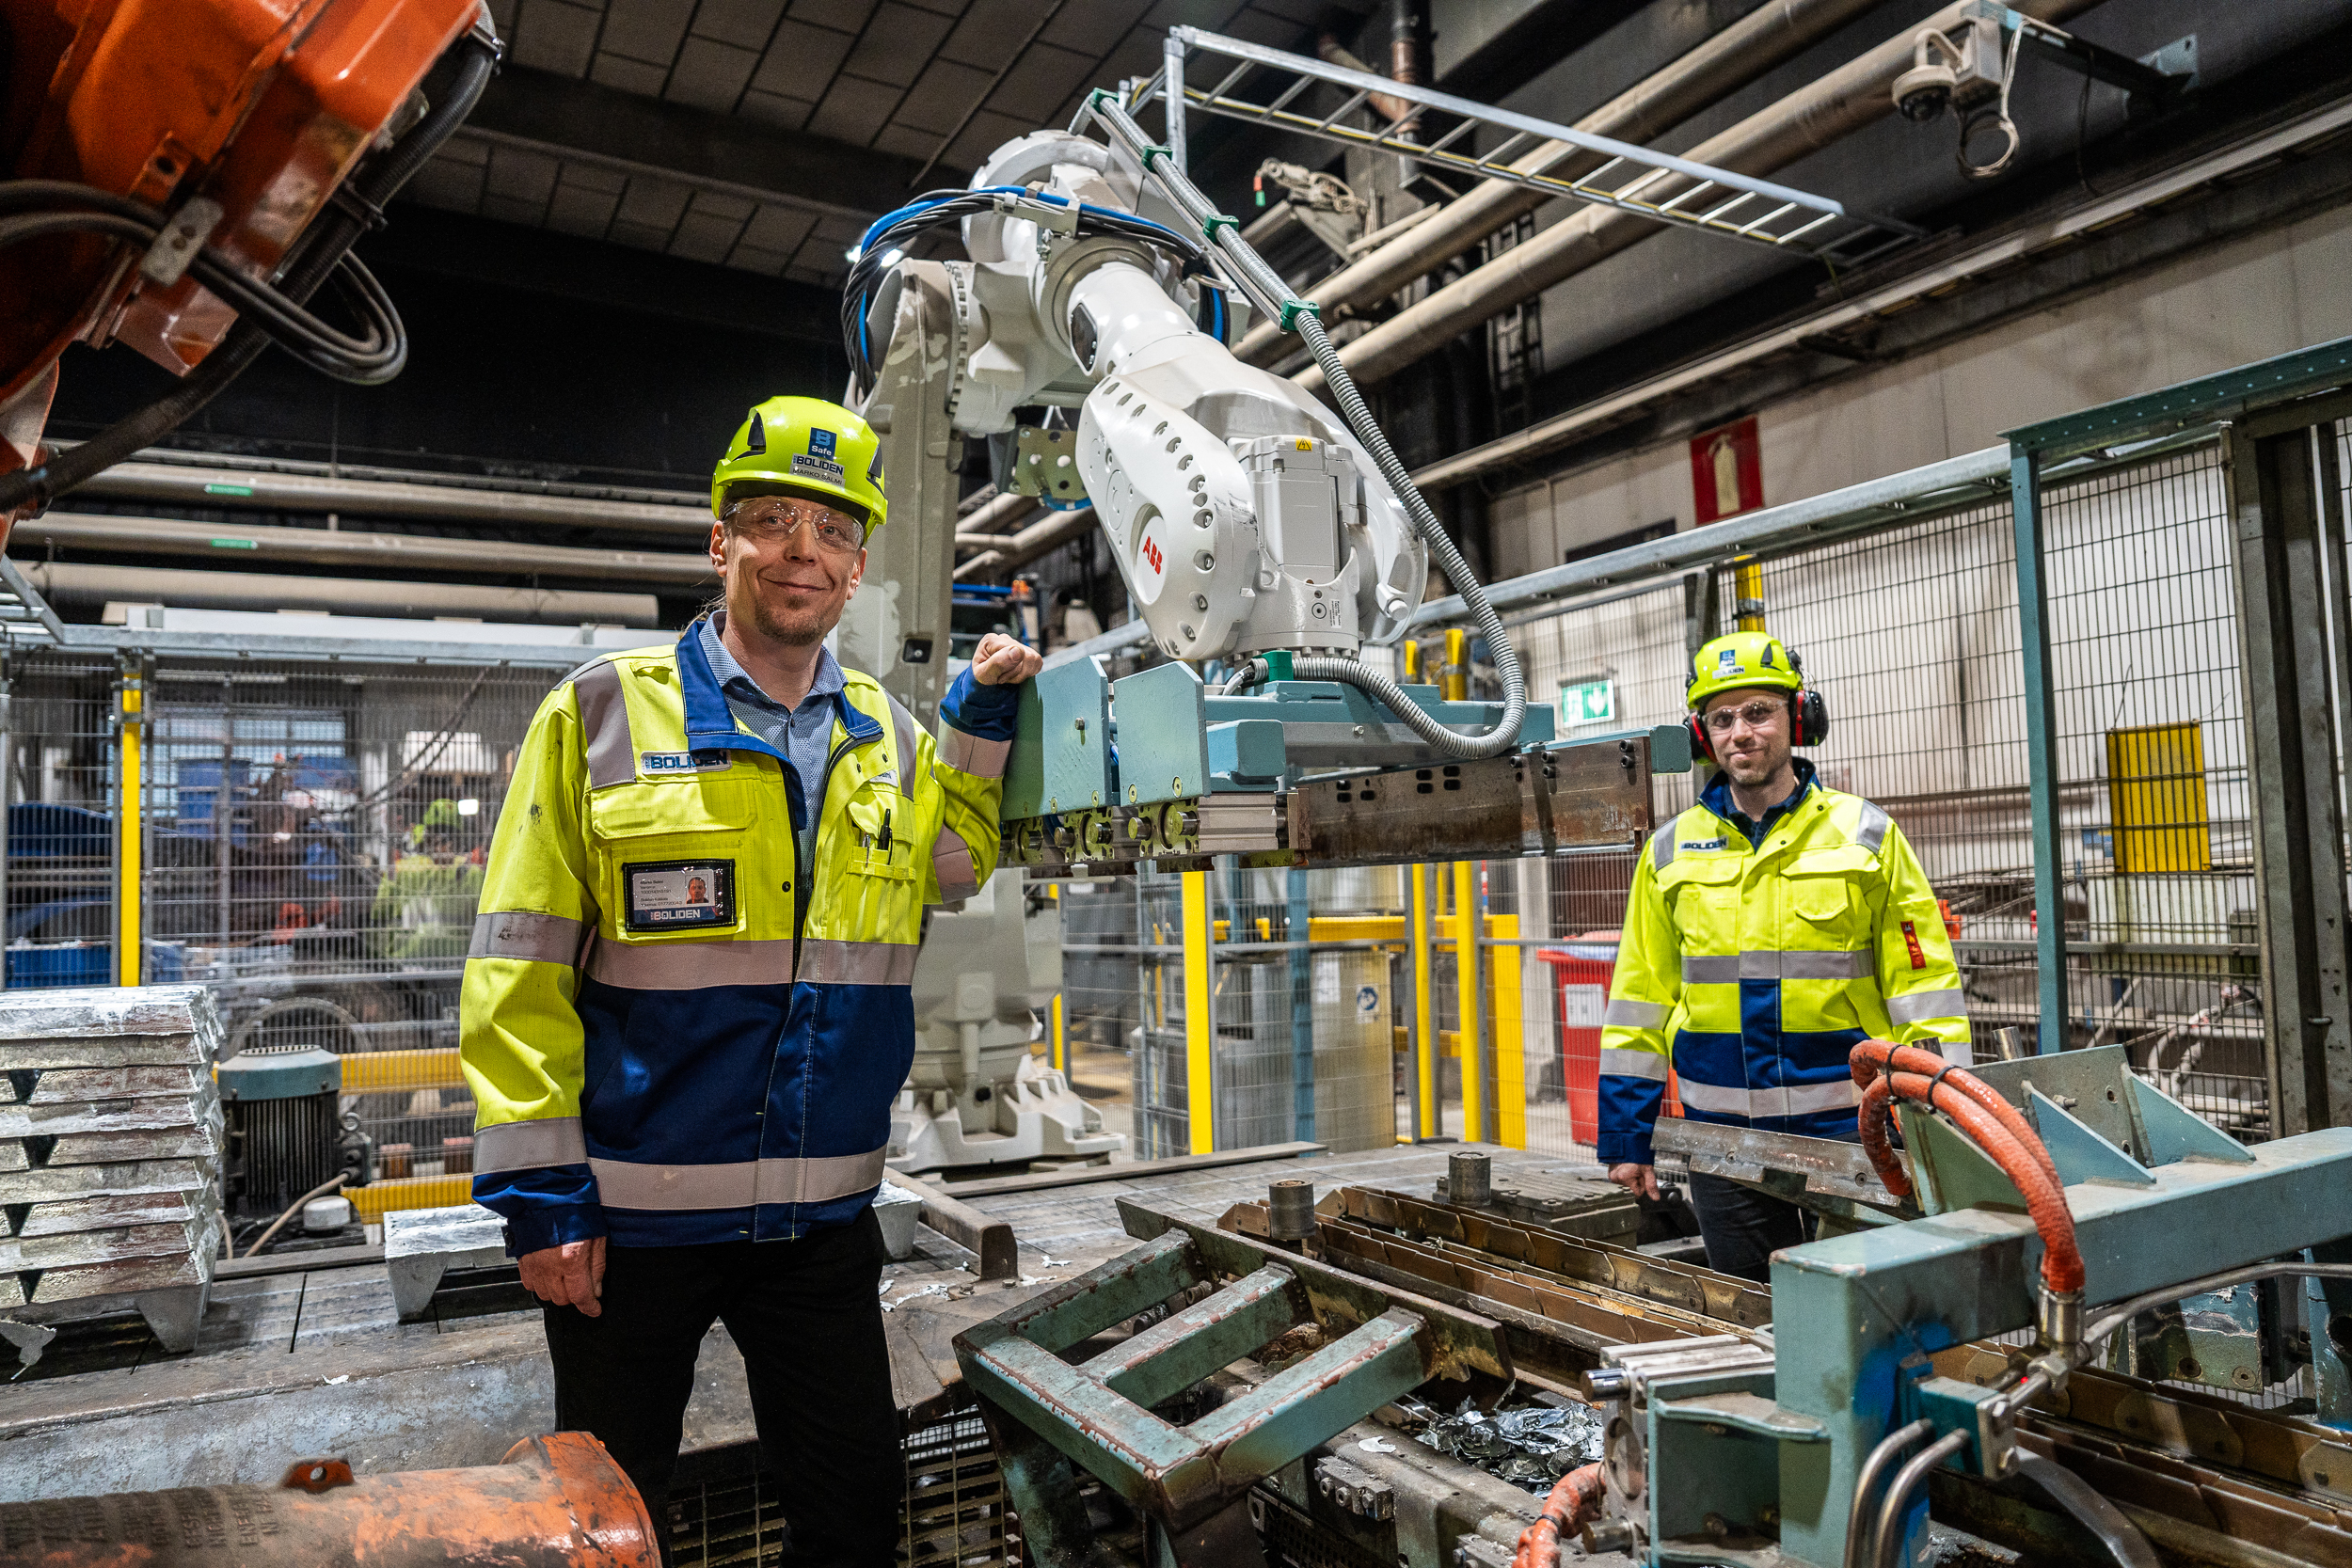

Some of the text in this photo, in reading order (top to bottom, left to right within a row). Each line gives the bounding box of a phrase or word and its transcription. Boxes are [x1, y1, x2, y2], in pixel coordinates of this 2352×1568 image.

[811, 445, 833, 456] Safe
[796, 455, 845, 476] BOLIDEN
[792, 467, 843, 485] MARKO SALMI
[1142, 535, 1163, 575] ABB
[1684, 837, 1727, 850] BOLIDEN
[653, 909, 701, 921] BOLIDEN
